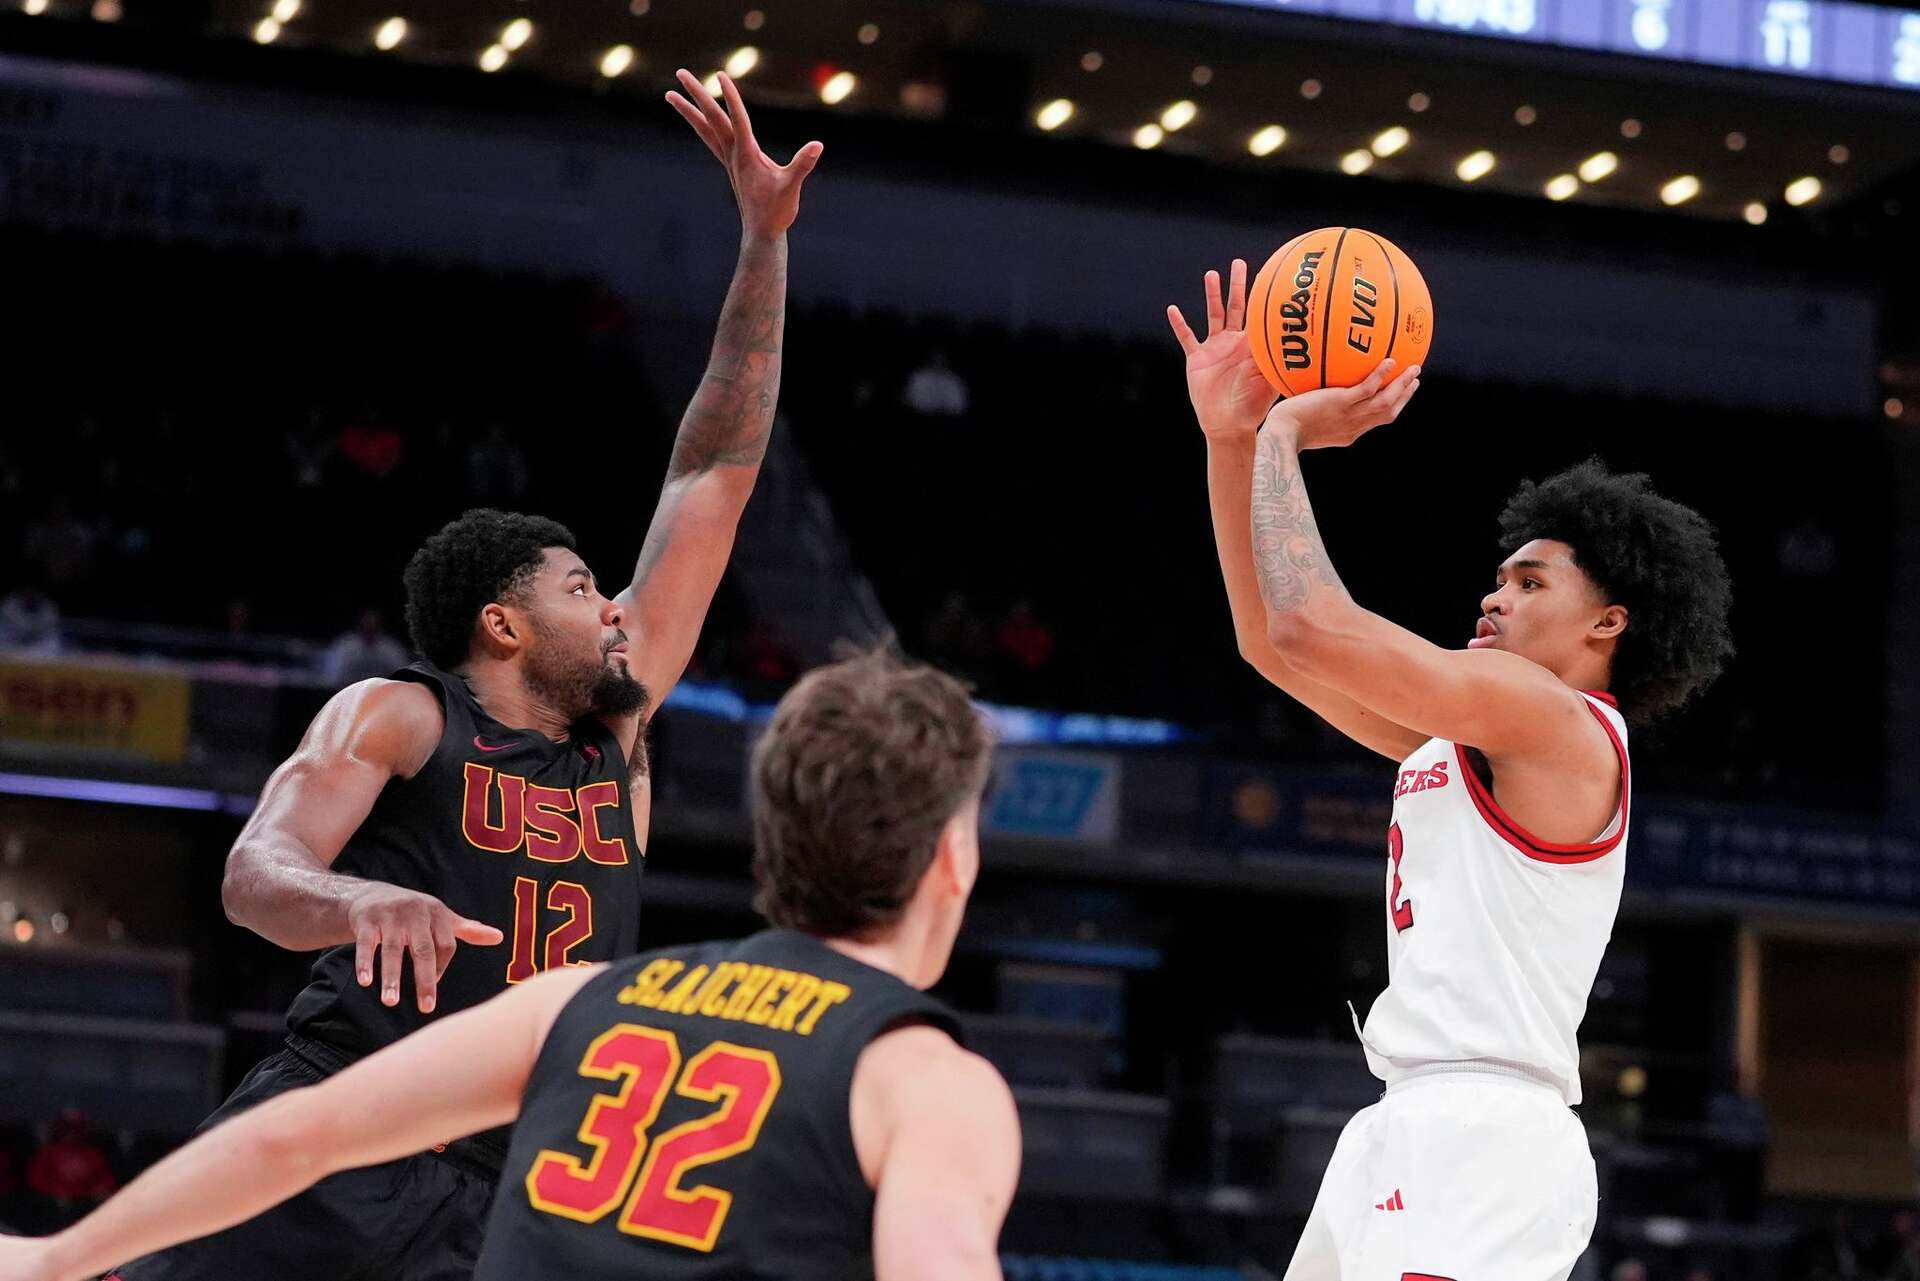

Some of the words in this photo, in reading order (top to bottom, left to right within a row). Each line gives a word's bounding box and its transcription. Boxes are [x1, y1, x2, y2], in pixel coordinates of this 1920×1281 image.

[1280, 250, 1325, 372] Wilson
[1348, 277, 1377, 354] EVO
[462, 761, 629, 866] USC
[506, 875, 593, 984] 12
[525, 1021, 783, 1253] 32
